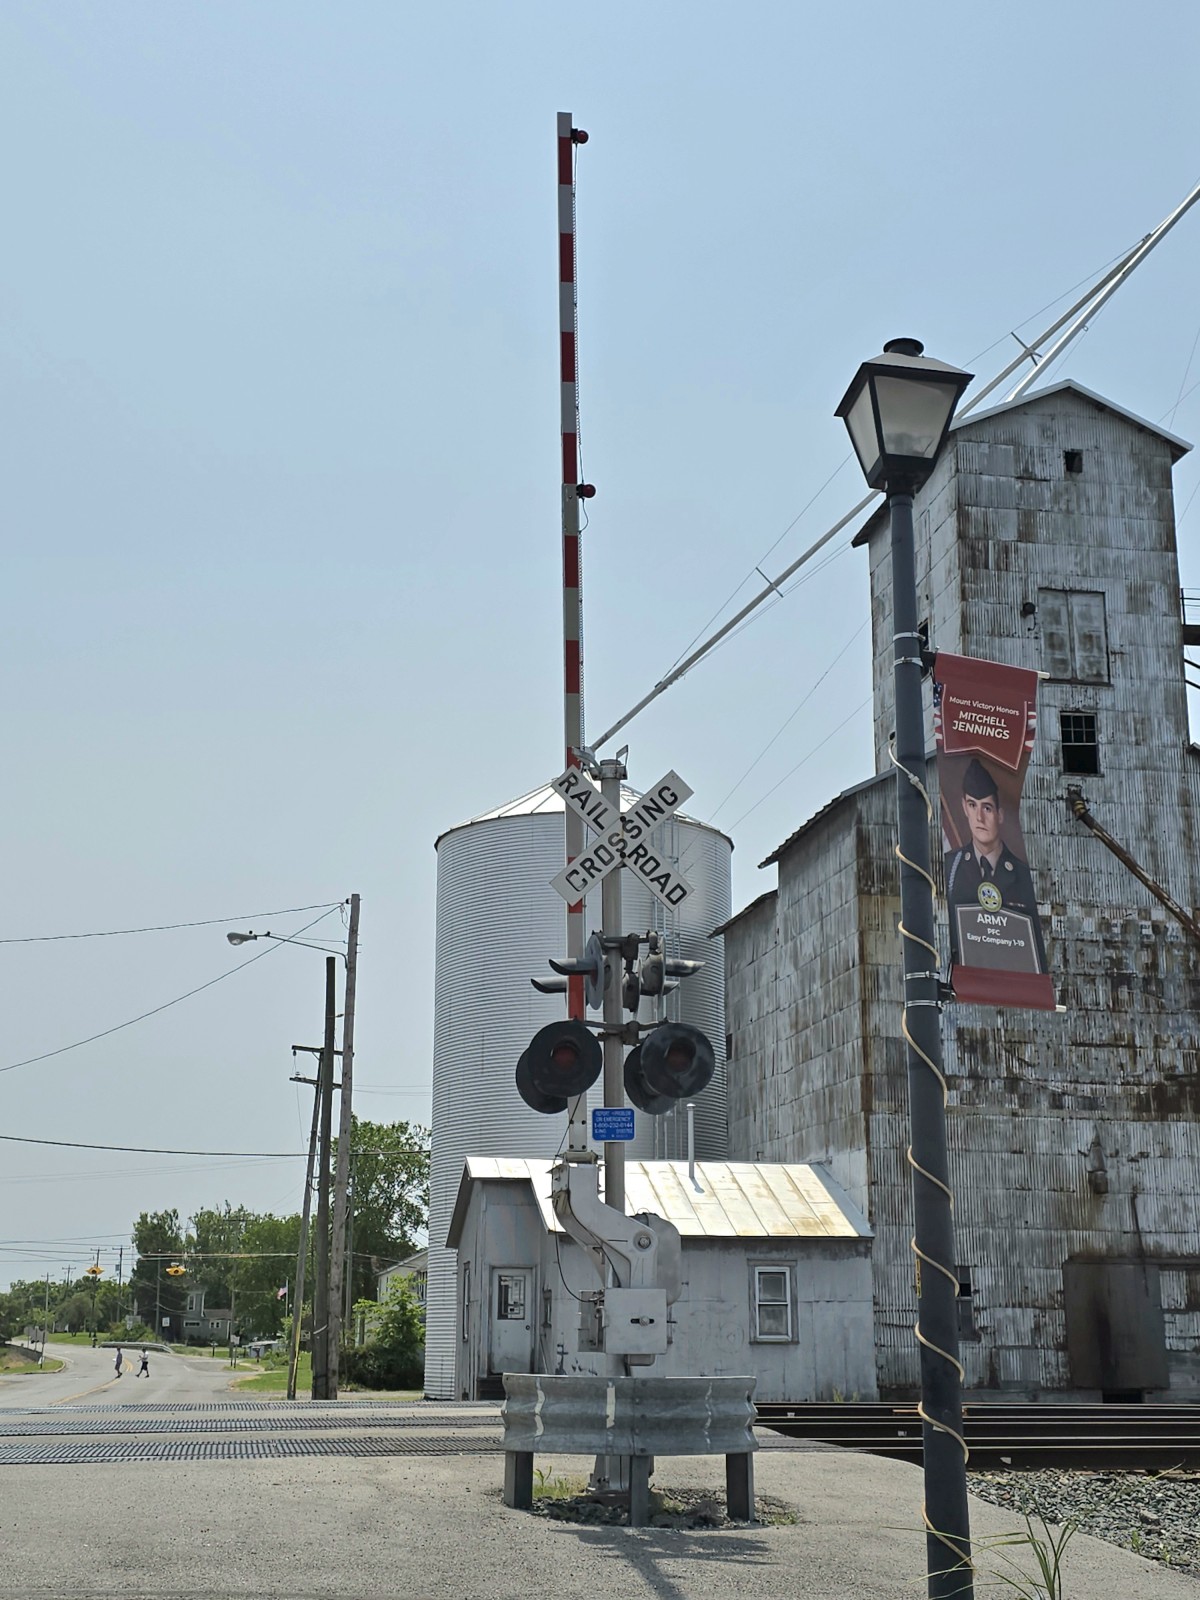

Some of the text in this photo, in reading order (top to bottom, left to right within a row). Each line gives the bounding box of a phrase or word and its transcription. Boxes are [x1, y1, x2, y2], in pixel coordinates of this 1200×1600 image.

[949, 696, 1020, 716] Mount Victory Honors
[958, 711, 1007, 727] MITCHELL
[952, 720, 1010, 740] JENNINGS
[558, 772, 608, 830] RAIL
[565, 785, 679, 892] CROSSING
[627, 842, 687, 906] ROAD
[976, 913, 1008, 927] ARMY
[966, 933, 981, 943] Easy
[982, 935, 1013, 947] Company
[987, 928, 1001, 936] PFC
